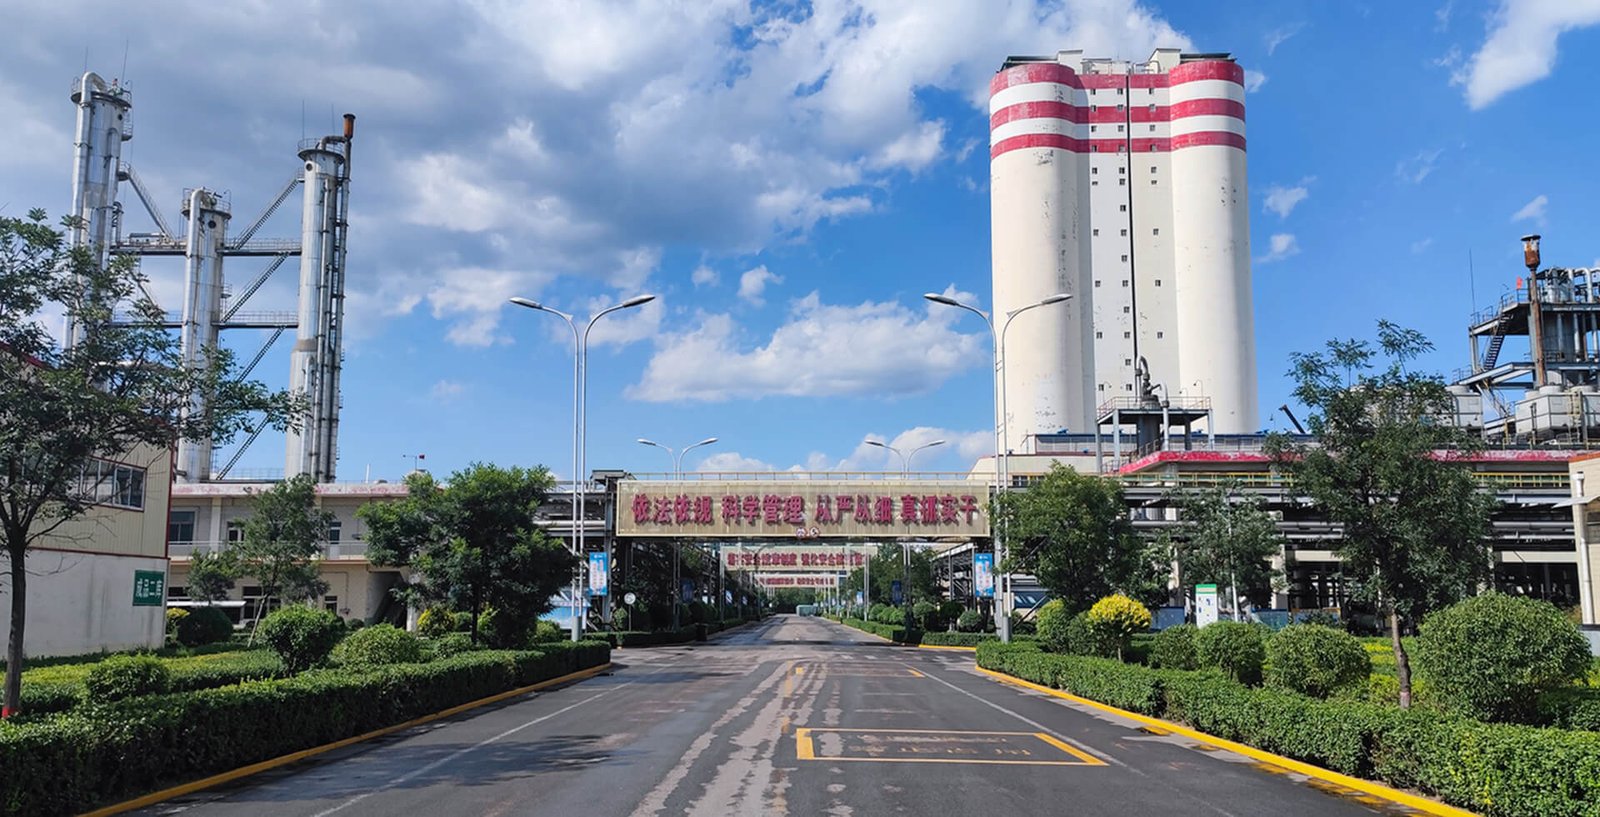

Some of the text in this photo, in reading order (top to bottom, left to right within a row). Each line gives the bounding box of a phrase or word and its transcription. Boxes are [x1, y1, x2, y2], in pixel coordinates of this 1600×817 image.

[632, 494, 978, 524] 依法依规 科学管理 从严从细 真抓实干
[135, 578, 163, 599] 成品二库
